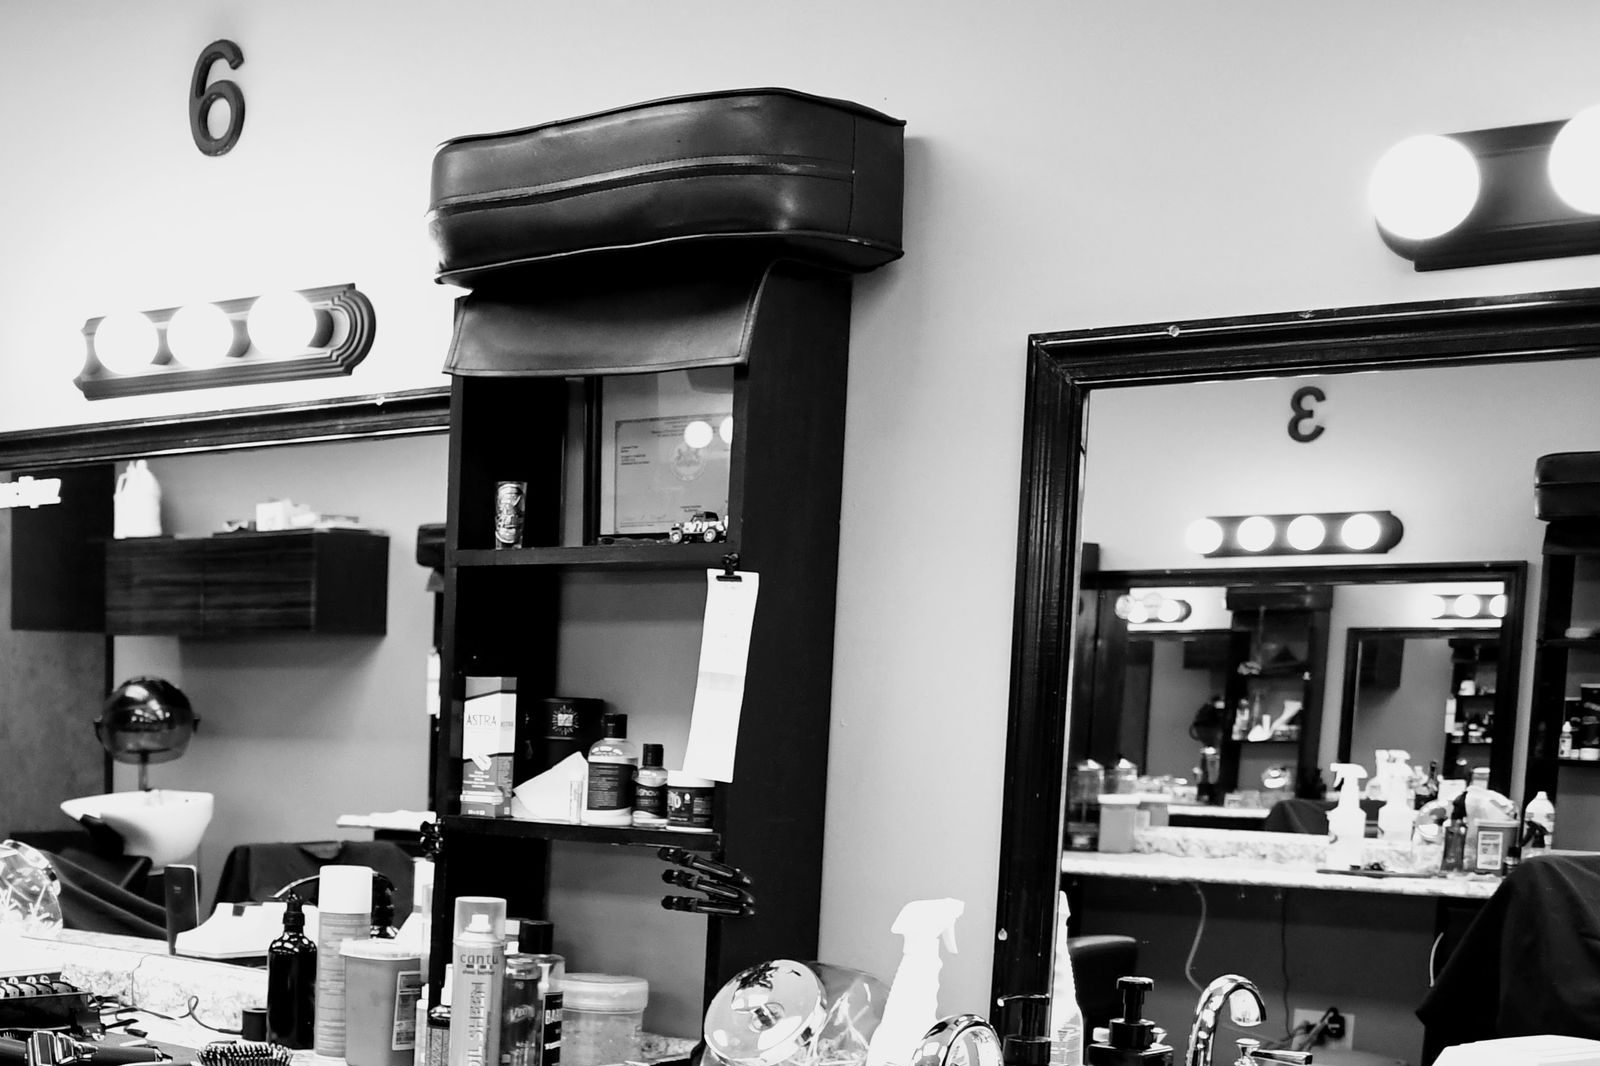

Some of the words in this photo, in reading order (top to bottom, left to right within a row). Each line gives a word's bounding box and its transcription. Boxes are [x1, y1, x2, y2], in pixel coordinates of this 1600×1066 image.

[189, 39, 245, 157] 6
[466, 714, 498, 727] ASTRA
[460, 952, 500, 965] cantu
